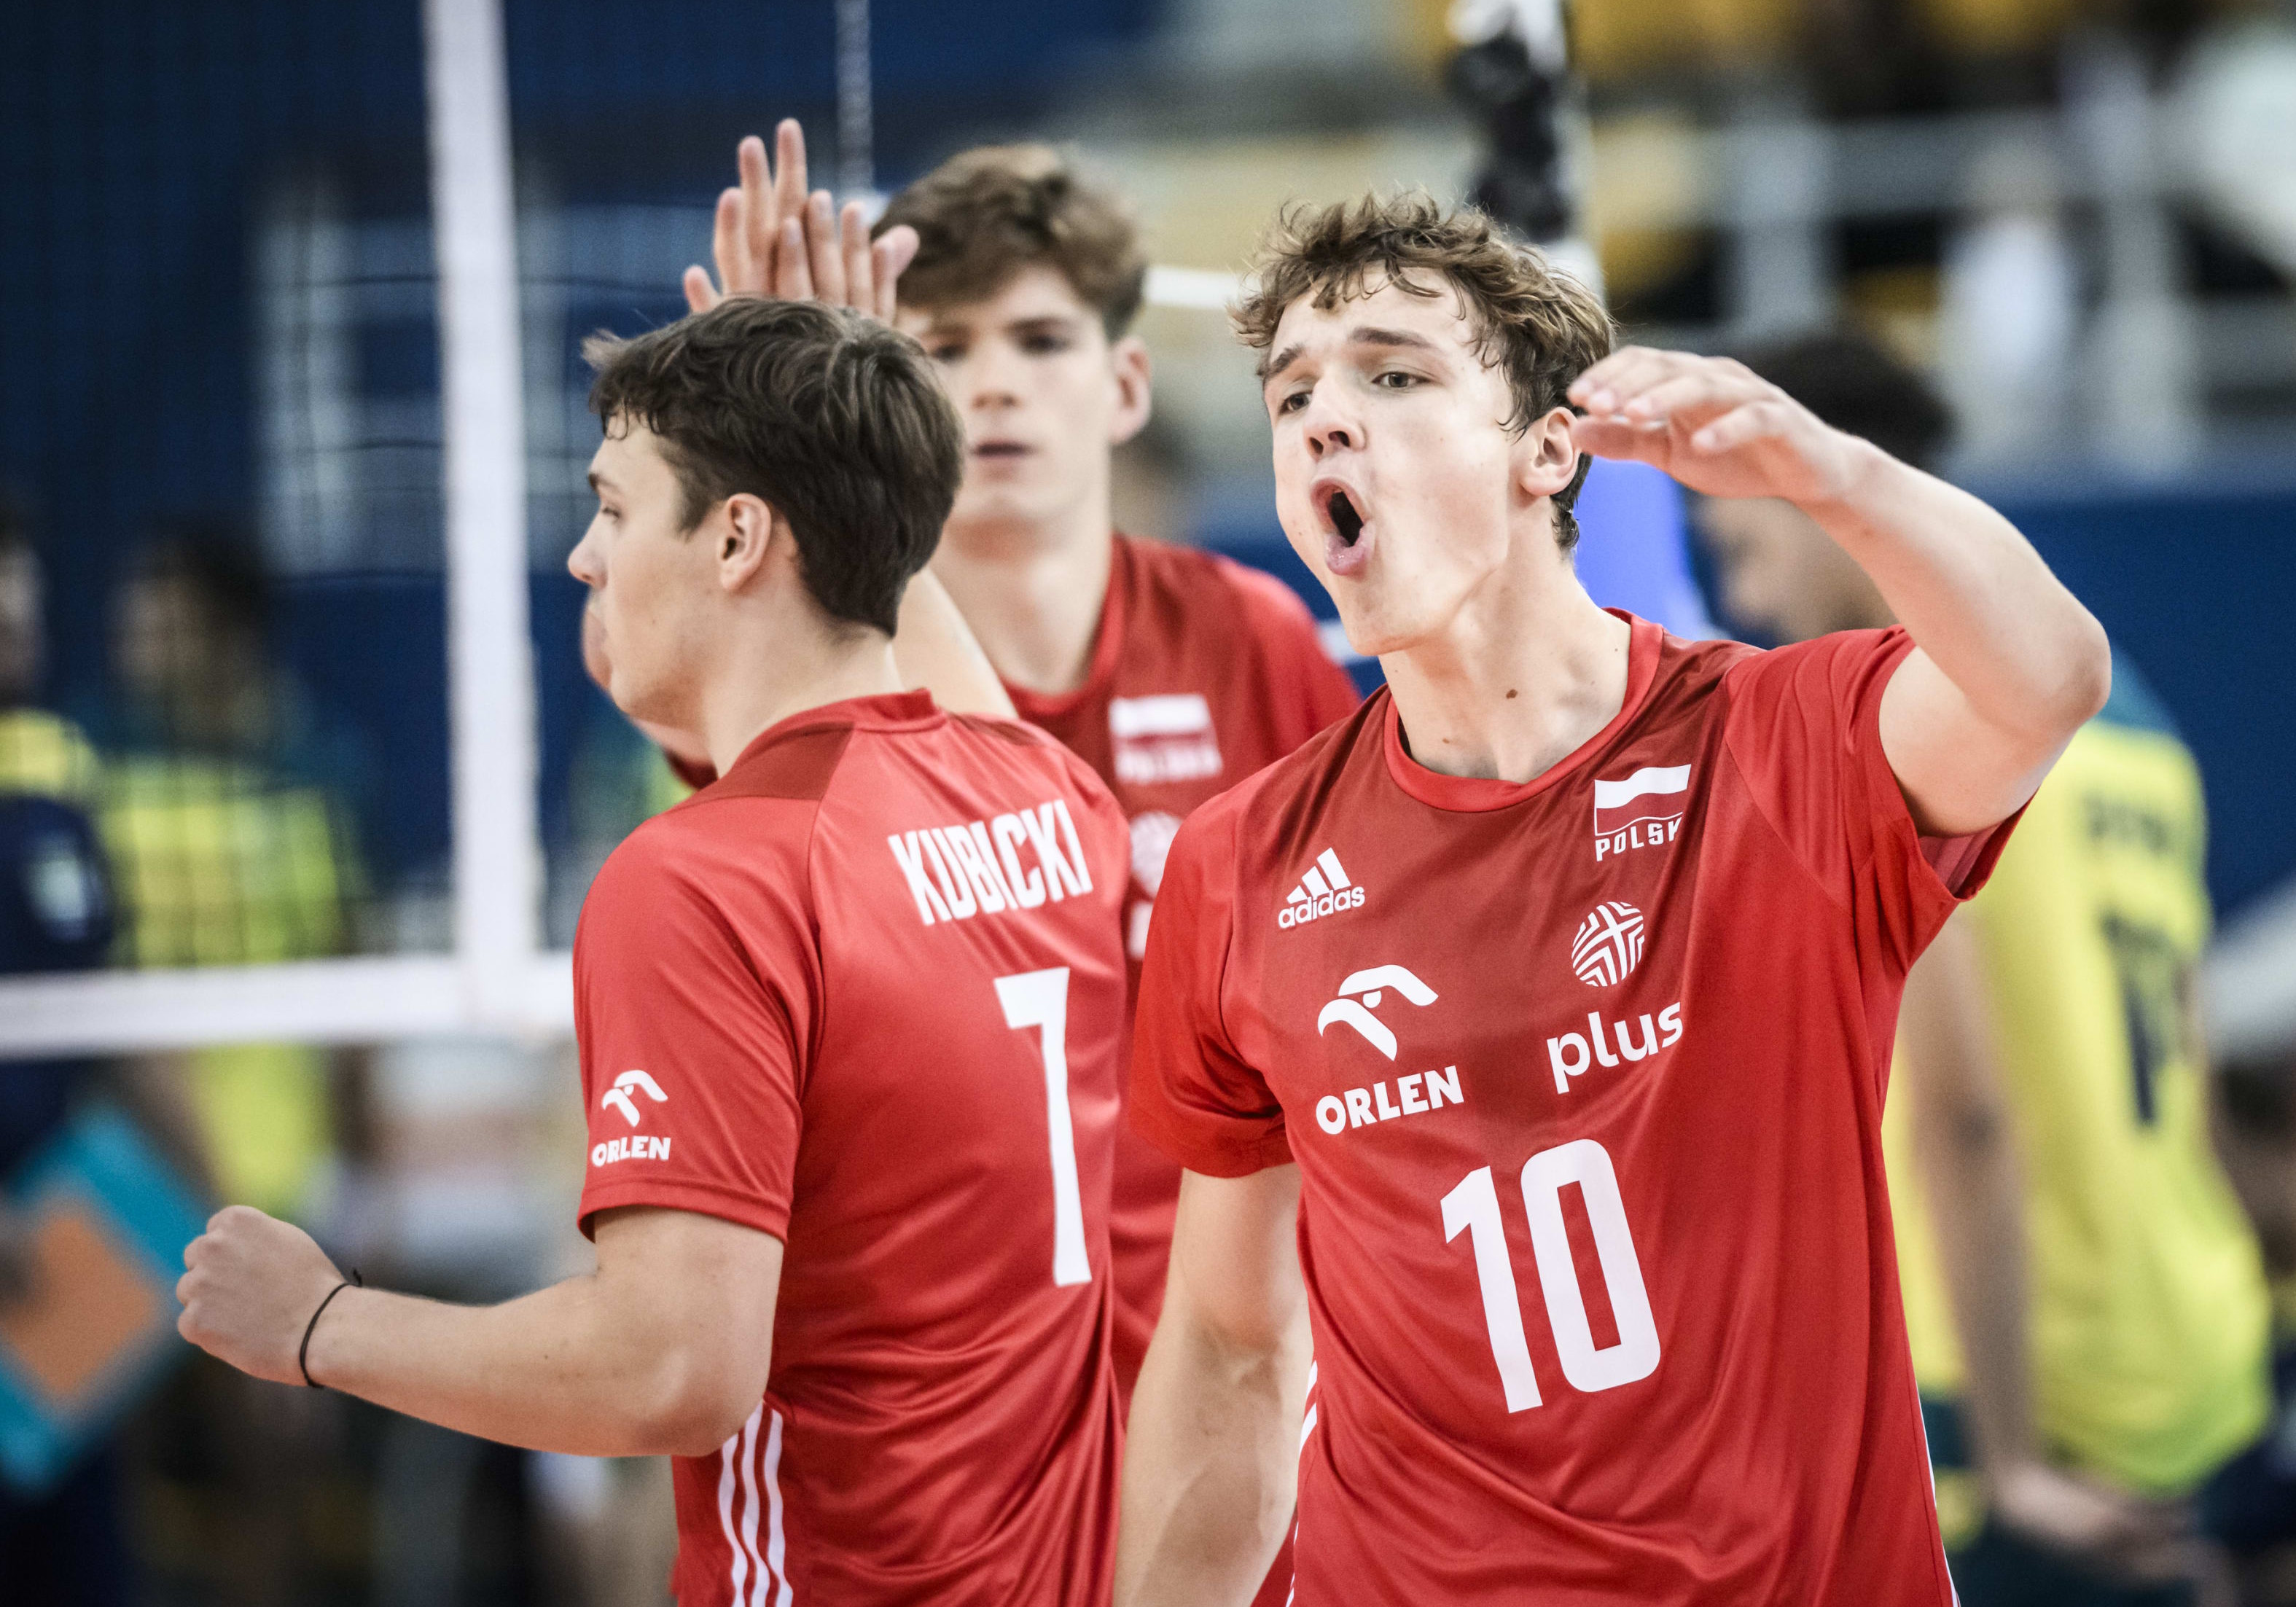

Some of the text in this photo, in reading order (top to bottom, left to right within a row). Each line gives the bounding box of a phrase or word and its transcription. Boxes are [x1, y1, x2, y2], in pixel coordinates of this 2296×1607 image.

[887, 799, 1093, 926] KUBICKI
[1278, 886, 1365, 928] adidas
[1547, 1001, 1683, 1094] plus
[993, 966, 1093, 1287] 7
[1316, 1065, 1464, 1135] ORLEN
[591, 1135, 671, 1168] ORLEN
[1440, 1138, 1661, 1414] 10
